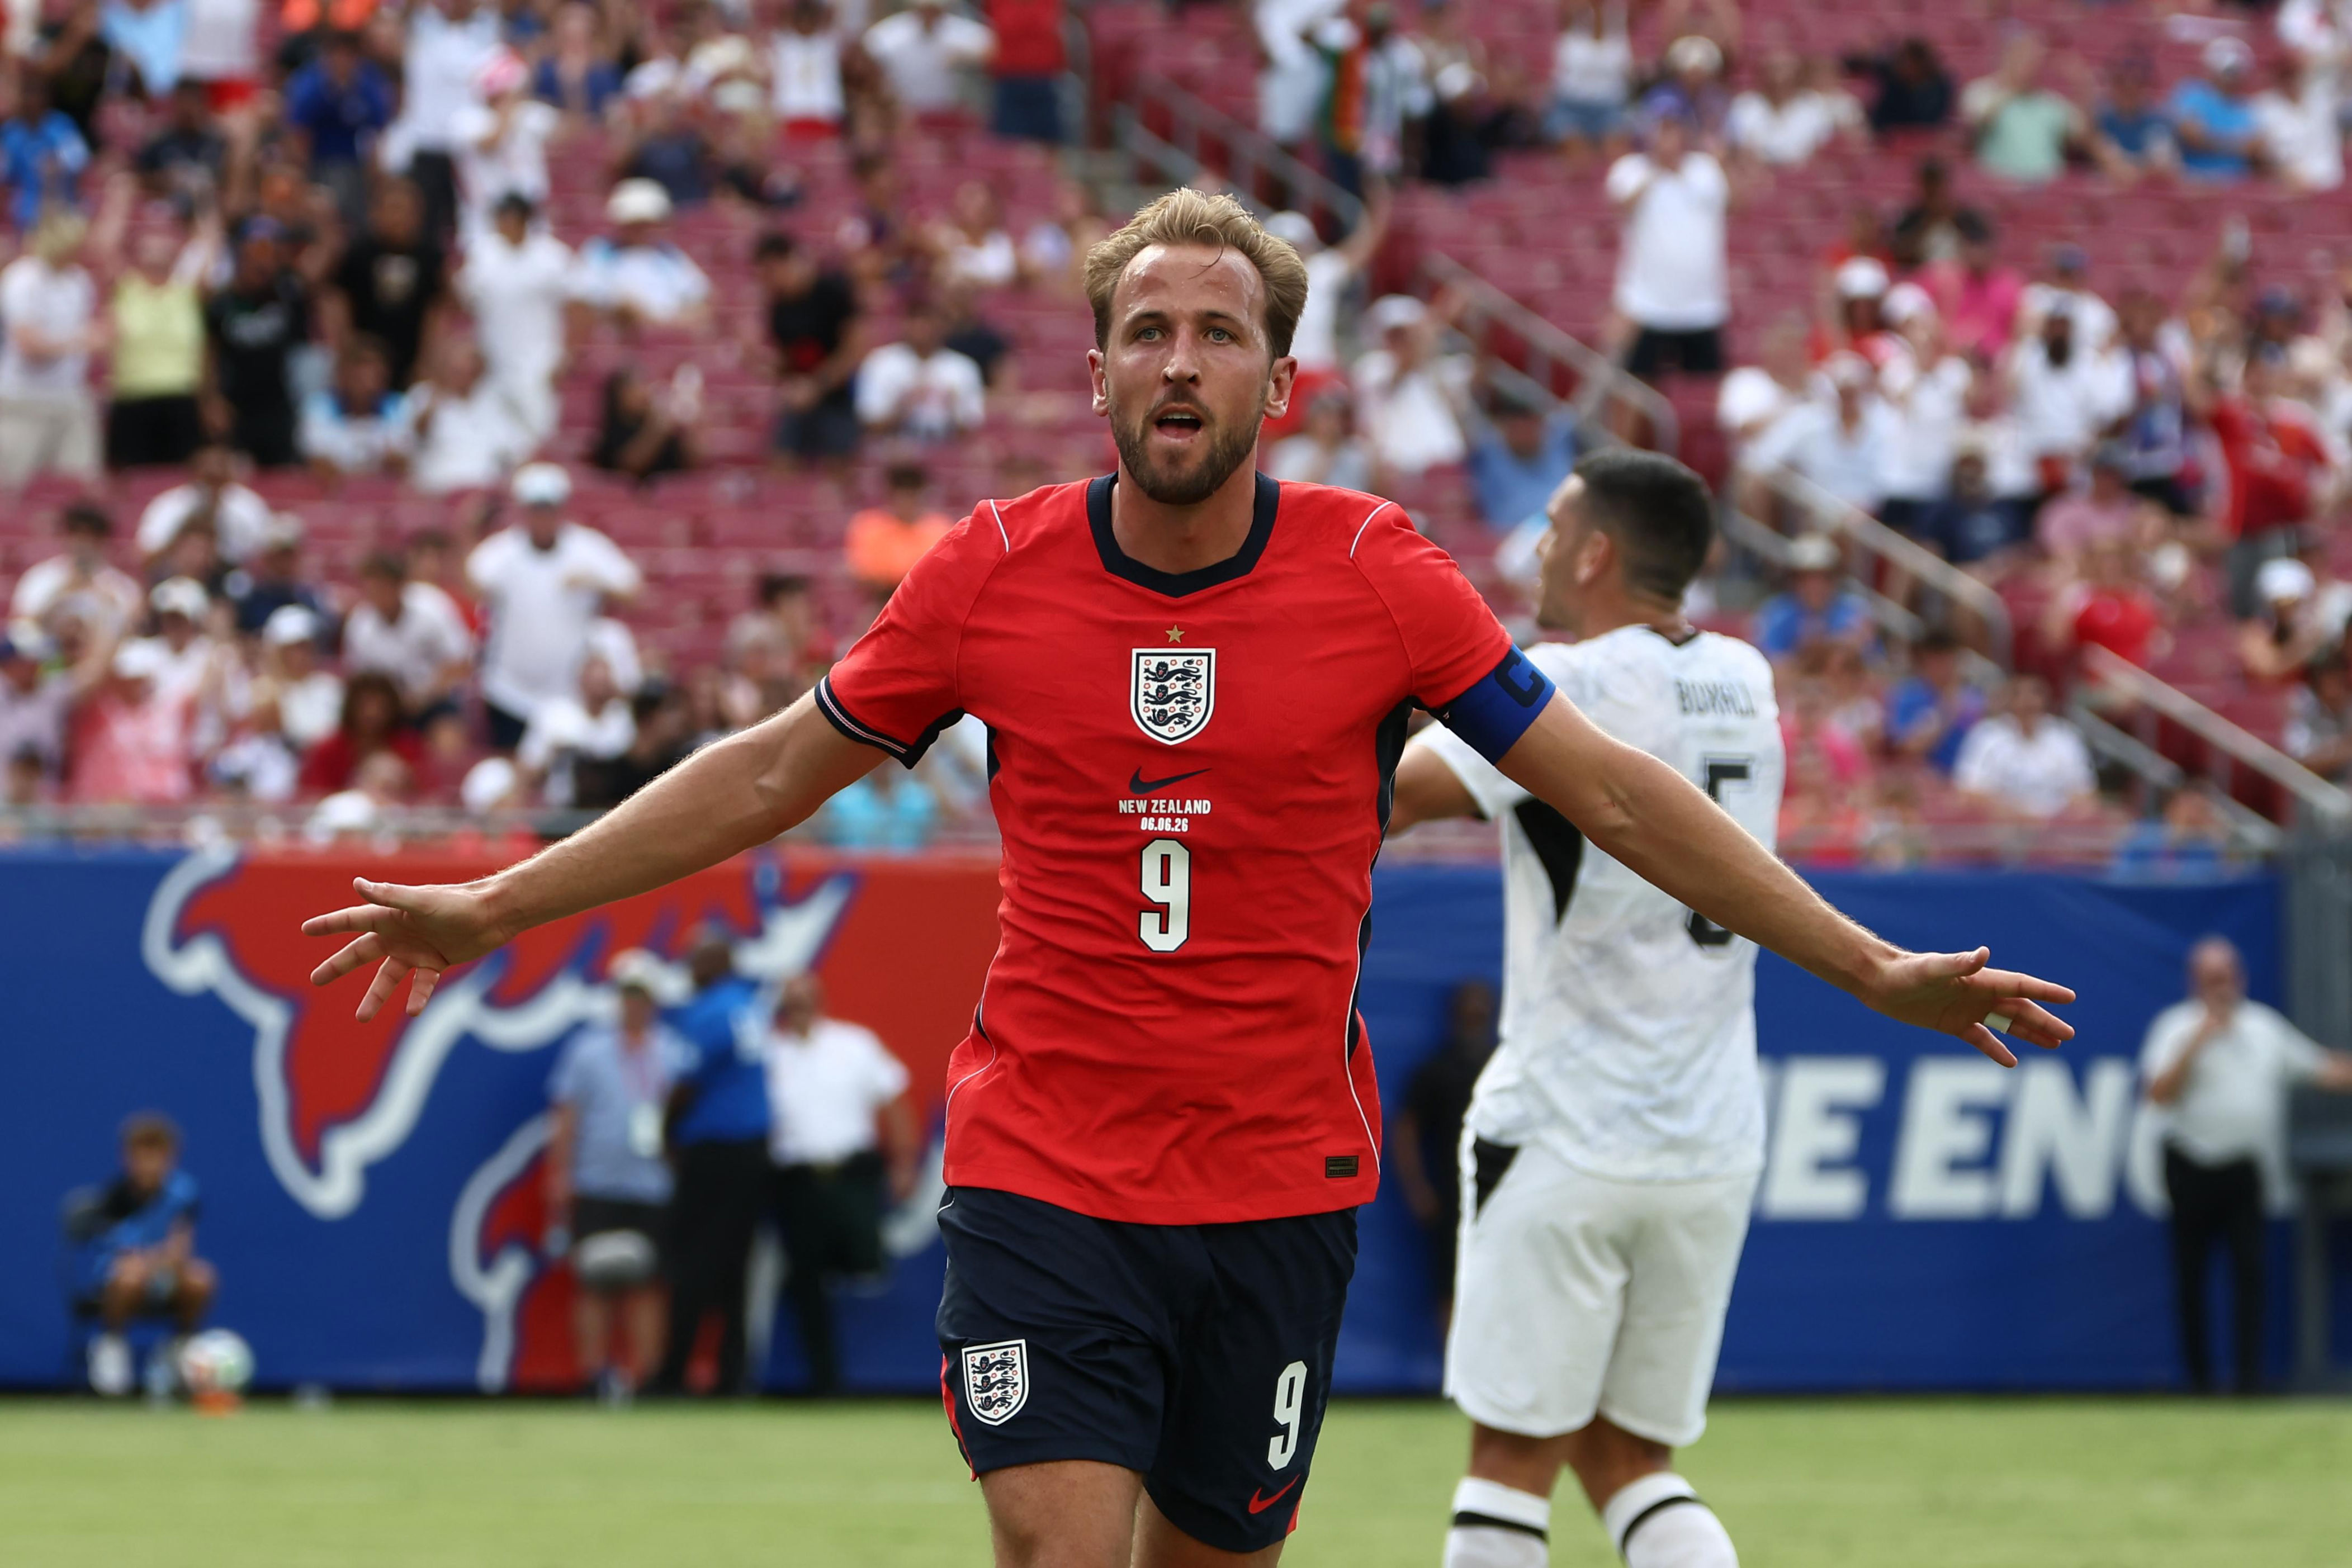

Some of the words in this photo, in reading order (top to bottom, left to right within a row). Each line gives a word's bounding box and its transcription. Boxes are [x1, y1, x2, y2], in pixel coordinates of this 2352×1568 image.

[1494, 649, 1546, 708] C
[1119, 799, 1148, 813] NEW
[1151, 799, 1211, 814] ZEALAND
[1140, 817, 1189, 832] 06.06.26
[1138, 838, 1191, 953] 9
[1757, 1055, 1886, 1220] E
[1267, 1360, 1308, 1471] 9
